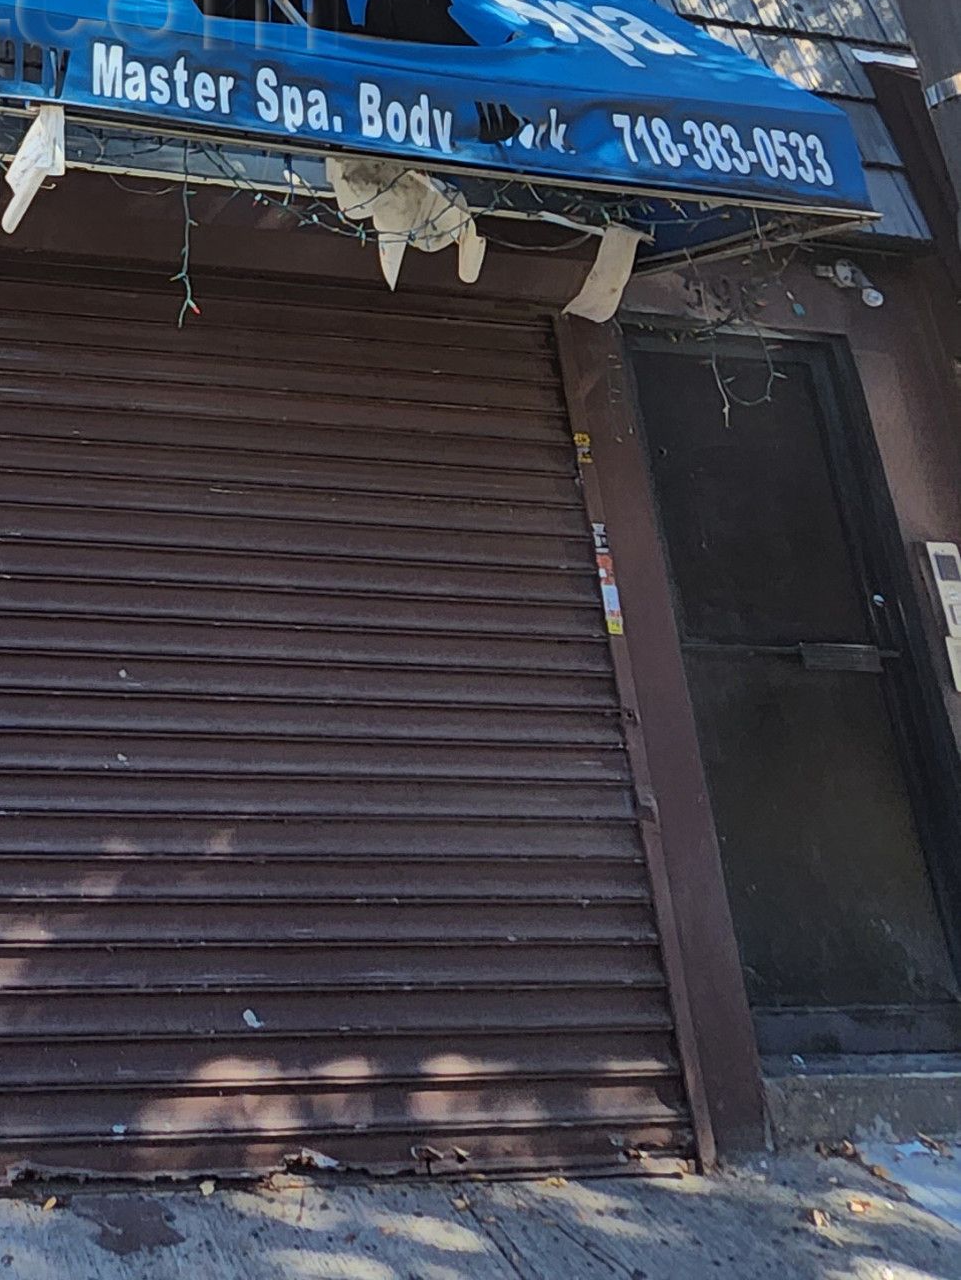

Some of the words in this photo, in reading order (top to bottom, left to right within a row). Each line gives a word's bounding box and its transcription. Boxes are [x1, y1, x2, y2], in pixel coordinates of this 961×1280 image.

[92, 41, 235, 114] Master
[358, 82, 454, 155] Body
[612, 113, 834, 187] 718-383-0533
